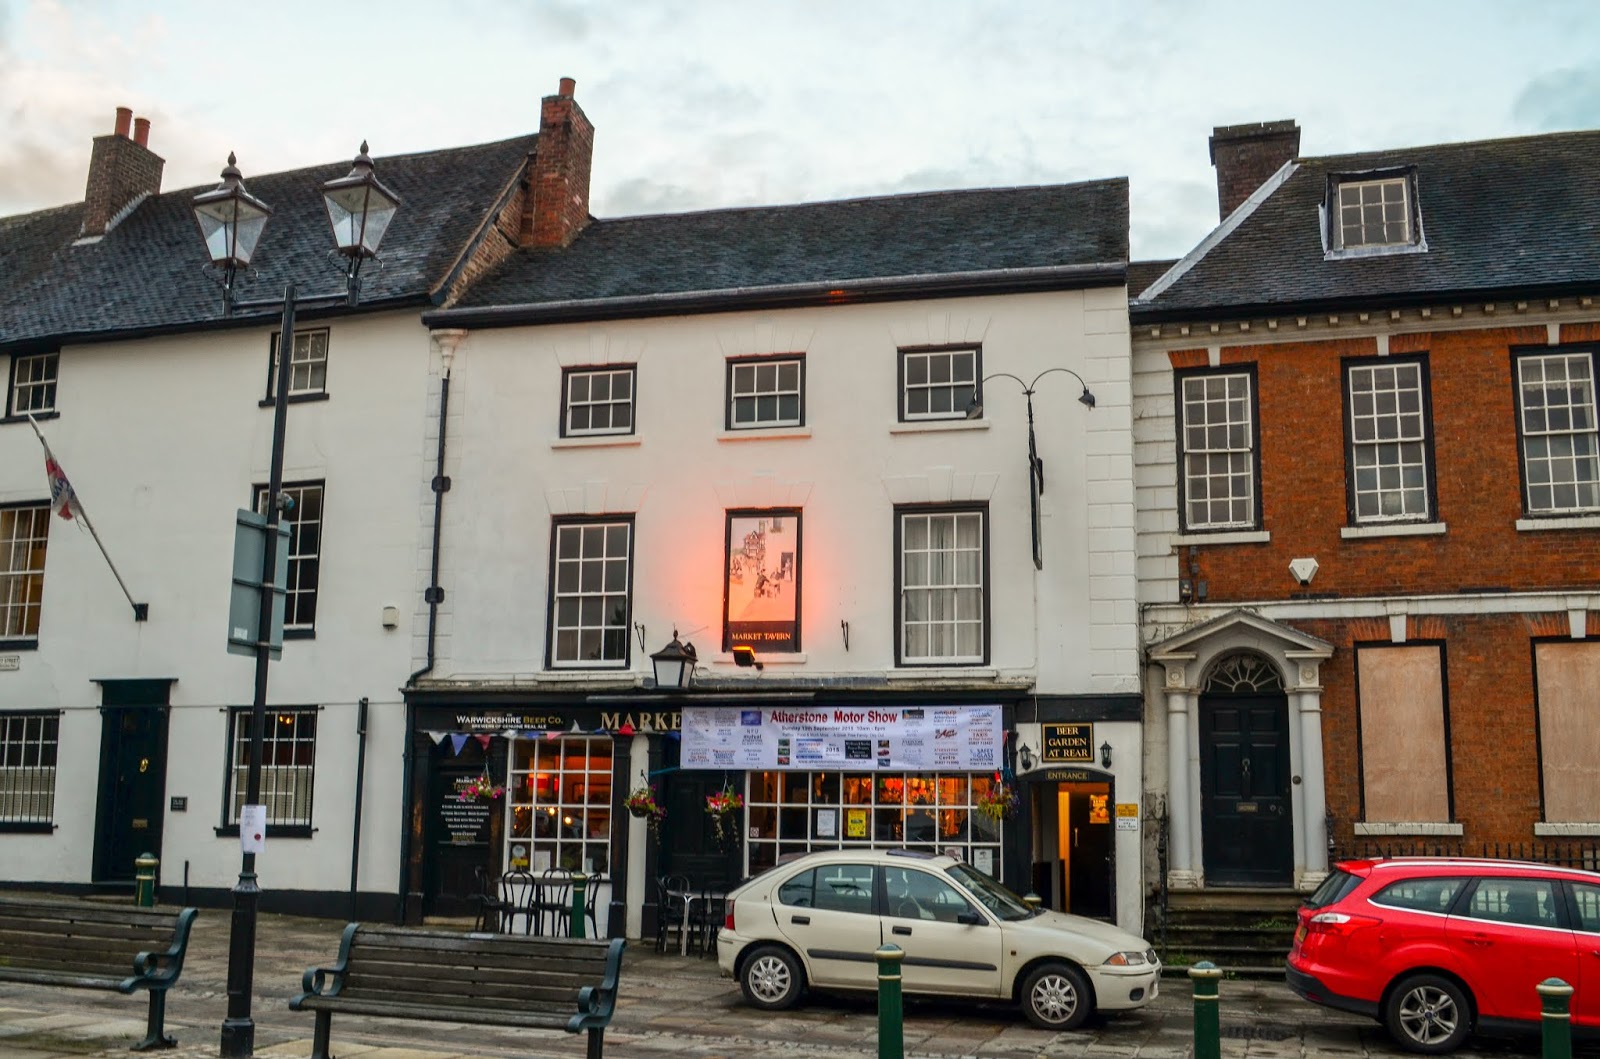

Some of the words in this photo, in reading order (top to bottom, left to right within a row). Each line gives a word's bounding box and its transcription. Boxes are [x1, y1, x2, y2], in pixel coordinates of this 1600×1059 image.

[456, 715, 521, 724] WARWICKSHIRE
[523, 716, 546, 724] BEER
[548, 716, 564, 724] CO.
[770, 709, 828, 724] Atherstone
[834, 710, 865, 724] Motor
[868, 710, 898, 724] Show
[1056, 727, 1079, 735] BEER
[1048, 738, 1086, 746] GARDEN
[1048, 749, 1060, 757] AT
[1064, 749, 1088, 757] REAR
[1048, 772, 1087, 780] ENTRANCE
